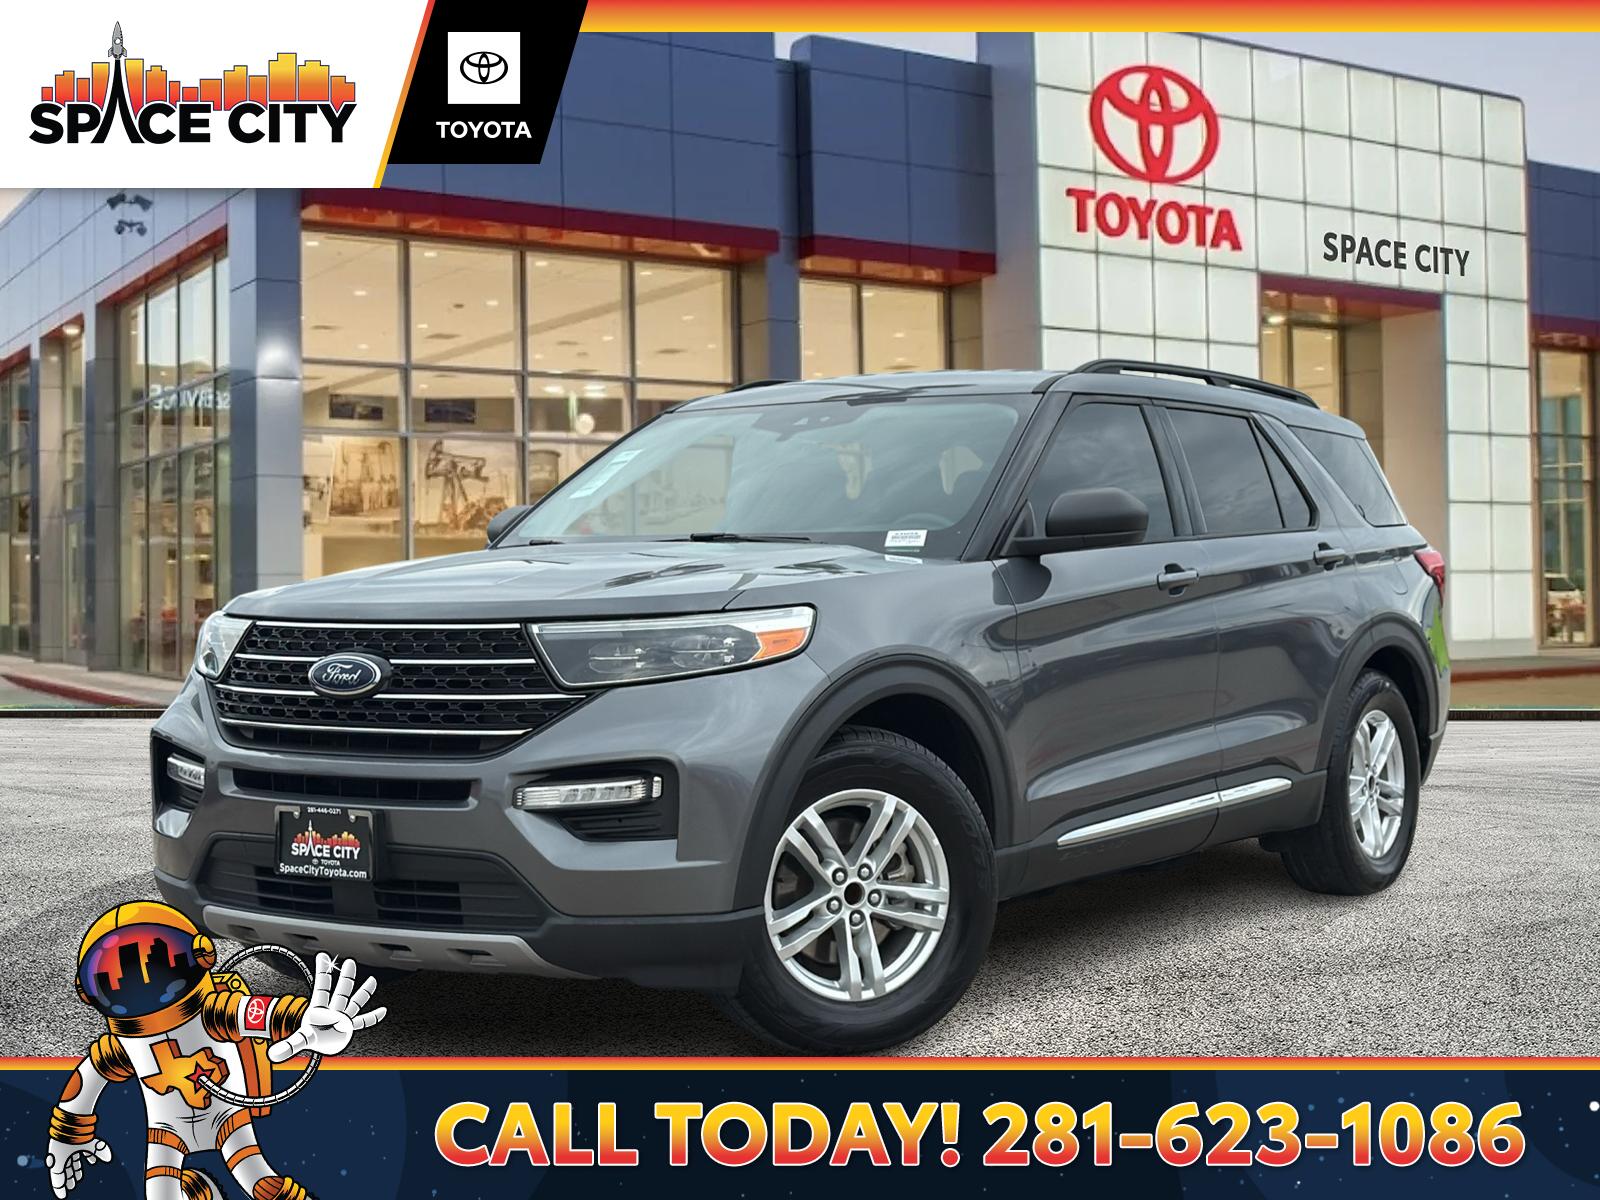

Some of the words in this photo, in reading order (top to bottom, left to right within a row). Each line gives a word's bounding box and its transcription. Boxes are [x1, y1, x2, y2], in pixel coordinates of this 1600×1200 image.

[1066, 188, 1242, 251] TOYOTA
[1323, 232, 1407, 270] SPACE
[1415, 244, 1470, 277] CITY
[322, 662, 362, 684] Ford
[333, 846, 360, 860] CITY
[280, 863, 367, 878] SpaceCityToyota.com
